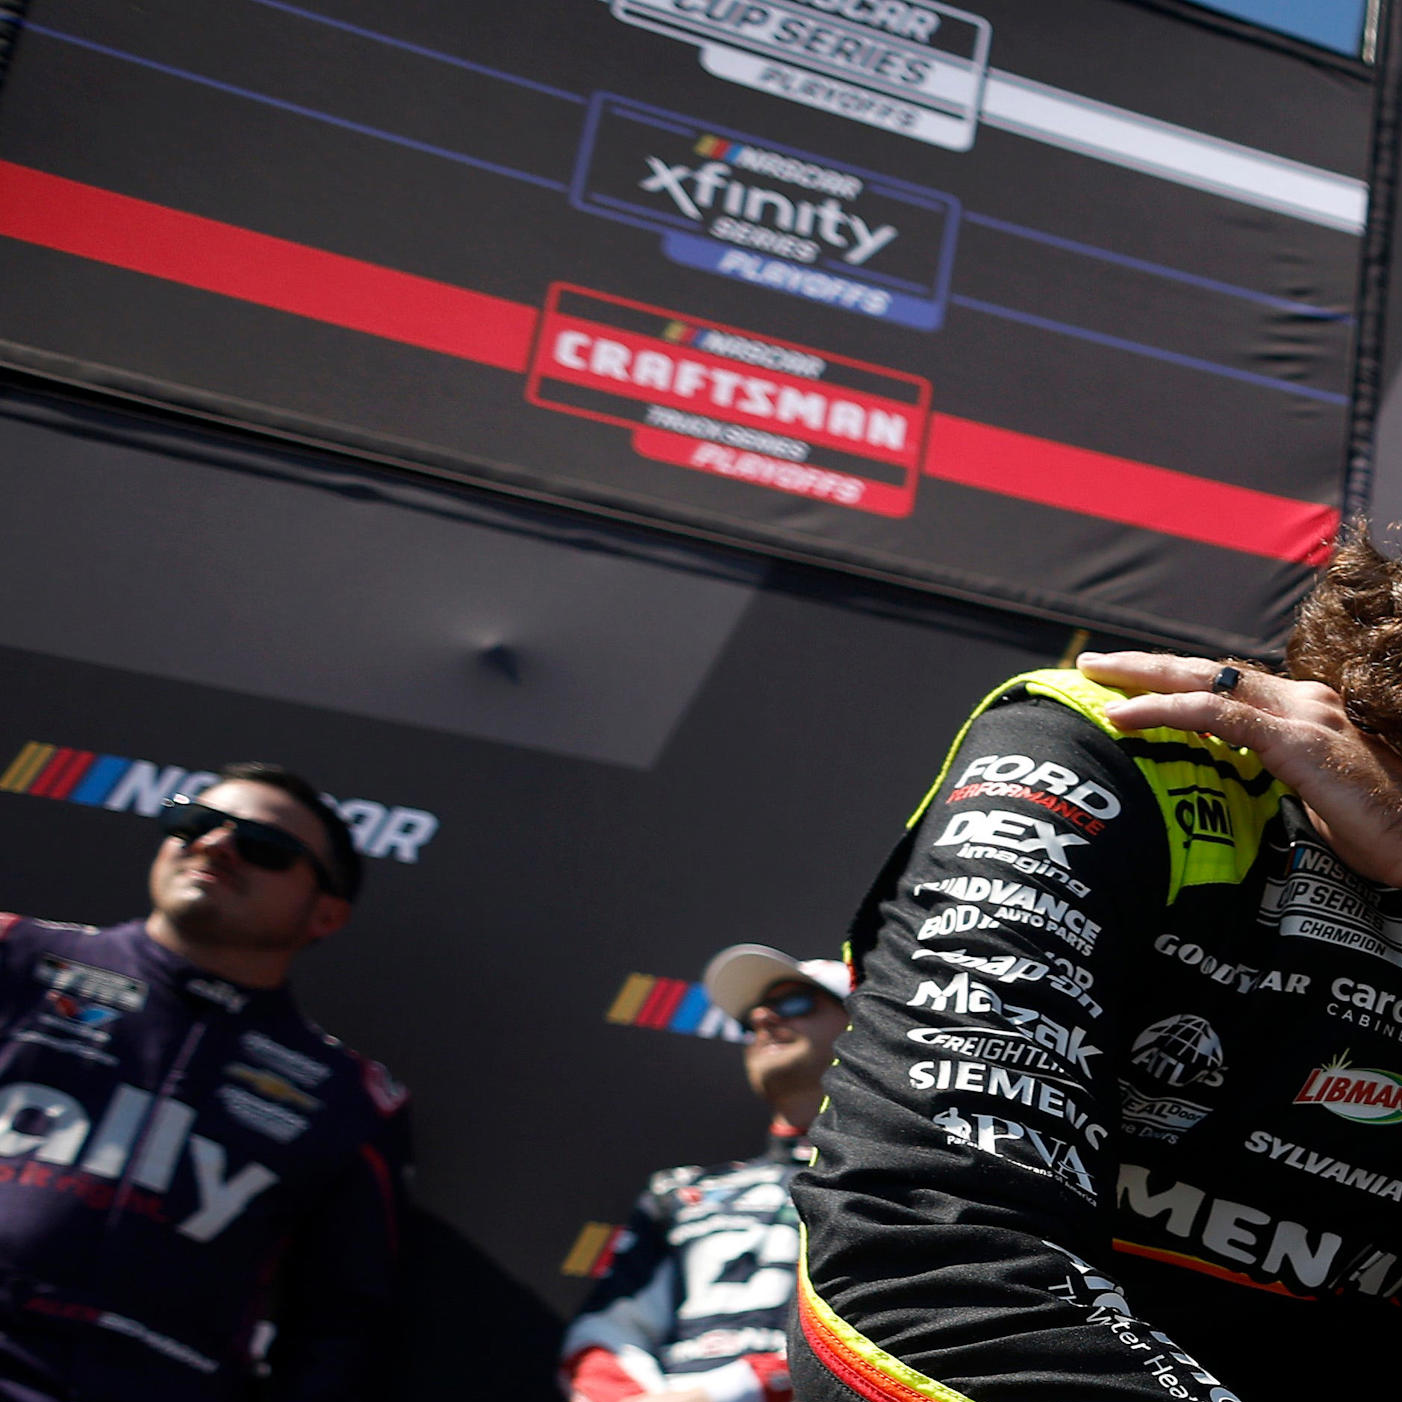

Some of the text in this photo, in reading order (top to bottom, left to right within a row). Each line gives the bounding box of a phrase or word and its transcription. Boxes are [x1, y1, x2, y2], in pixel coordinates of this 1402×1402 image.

[771, 17, 936, 88] SERIES
[758, 64, 924, 130] PLAYOFFS
[734, 145, 864, 199] NASCAR
[638, 155, 899, 266] xfinity
[708, 218, 822, 264] SERIES
[716, 249, 893, 317] PLAYOFFS
[698, 329, 827, 379] NASCAR
[553, 330, 909, 452] CRAFTSMAN
[690, 441, 866, 504] PLAYOFFS
[720, 422, 812, 463] SERIES
[944, 781, 1106, 837] PERFORMANCE
[953, 754, 1122, 820] FORD
[933, 809, 1092, 871] DEX
[956, 842, 1092, 899] imaging
[946, 875, 1103, 942] ADVANCE
[995, 907, 1094, 957] AUTO PARTS
[1299, 920, 1387, 957] CHAMPION
[1309, 885, 1385, 932] SERIES
[906, 971, 1104, 1080] Mazak
[908, 1059, 1109, 1151] SIEMENS
[0, 1081, 281, 1243] ally
[971, 1112, 1098, 1196] PVA
